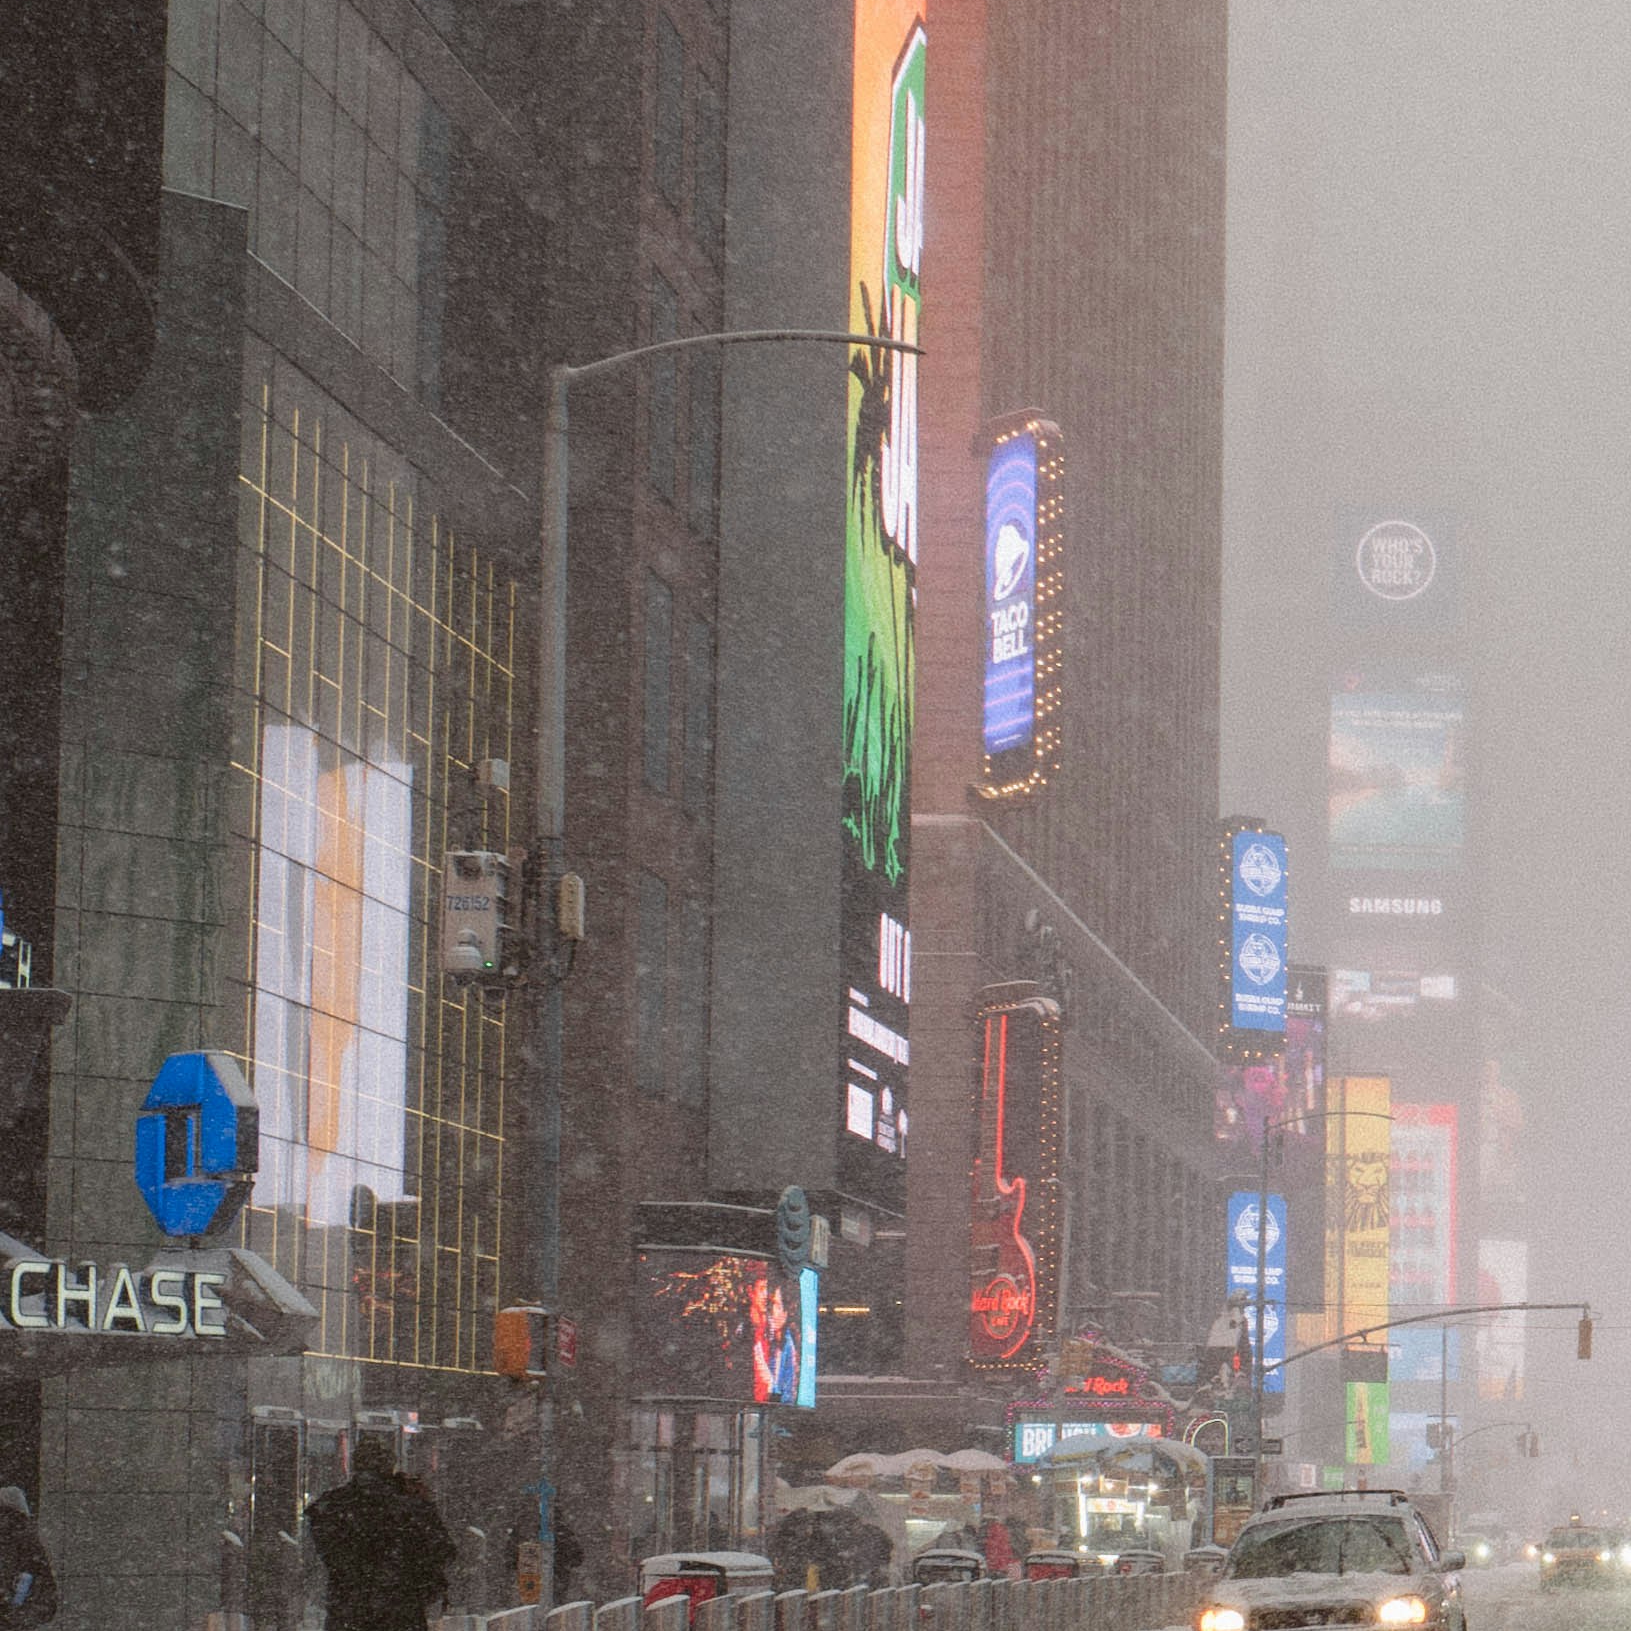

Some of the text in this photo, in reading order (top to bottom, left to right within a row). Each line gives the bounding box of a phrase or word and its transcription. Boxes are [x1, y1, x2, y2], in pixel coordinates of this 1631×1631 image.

[1371, 537, 1423, 554] WHO'S
[1371, 554, 1415, 569] YOUR
[1371, 569, 1421, 584] ROCK?
[991, 601, 1029, 635] TACO
[992, 632, 1028, 664] BELL
[447, 895, 490, 911] 726152
[1349, 897, 1443, 914] SAMSUNG
[10, 1260, 227, 1337] CHASE
[1000, 1289, 1029, 1315] Rock
[1092, 1377, 1128, 1396] Rock
